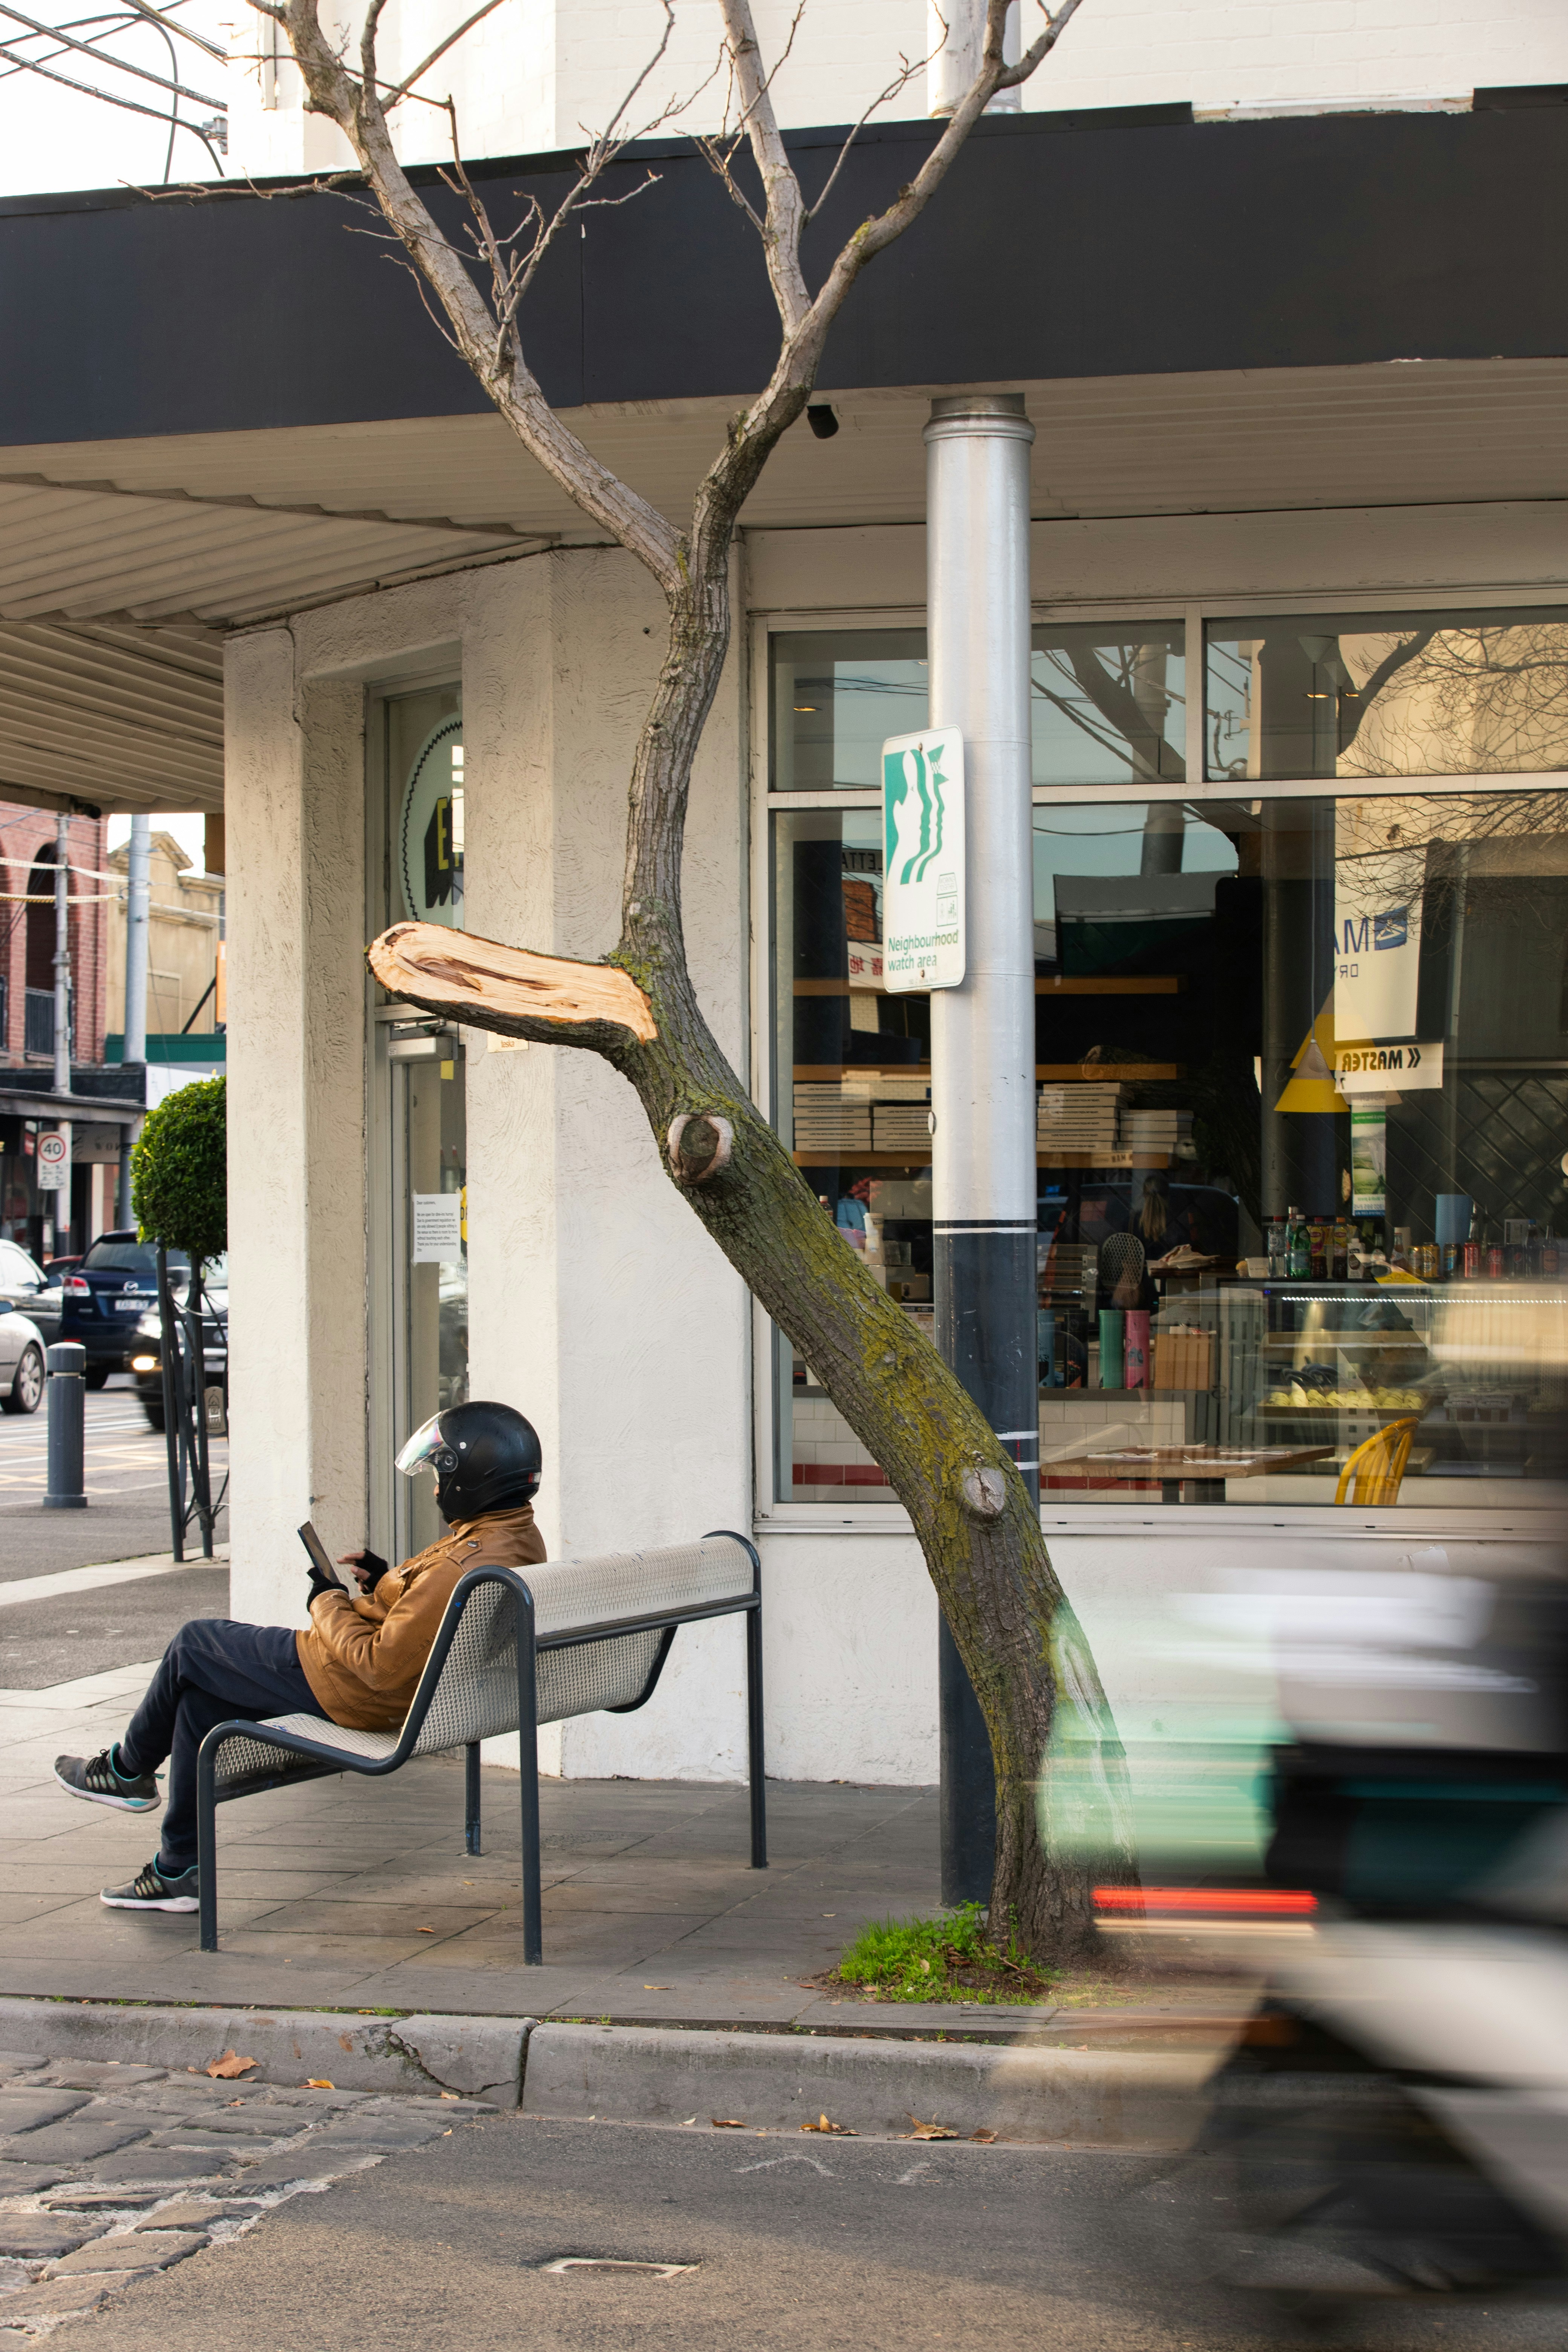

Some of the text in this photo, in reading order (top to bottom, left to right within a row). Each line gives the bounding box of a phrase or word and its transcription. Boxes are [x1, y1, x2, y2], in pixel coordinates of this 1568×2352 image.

[888, 929, 959, 956] Neighbourhood
[888, 954, 937, 971] watch area
[43, 1142, 61, 1155] 40
